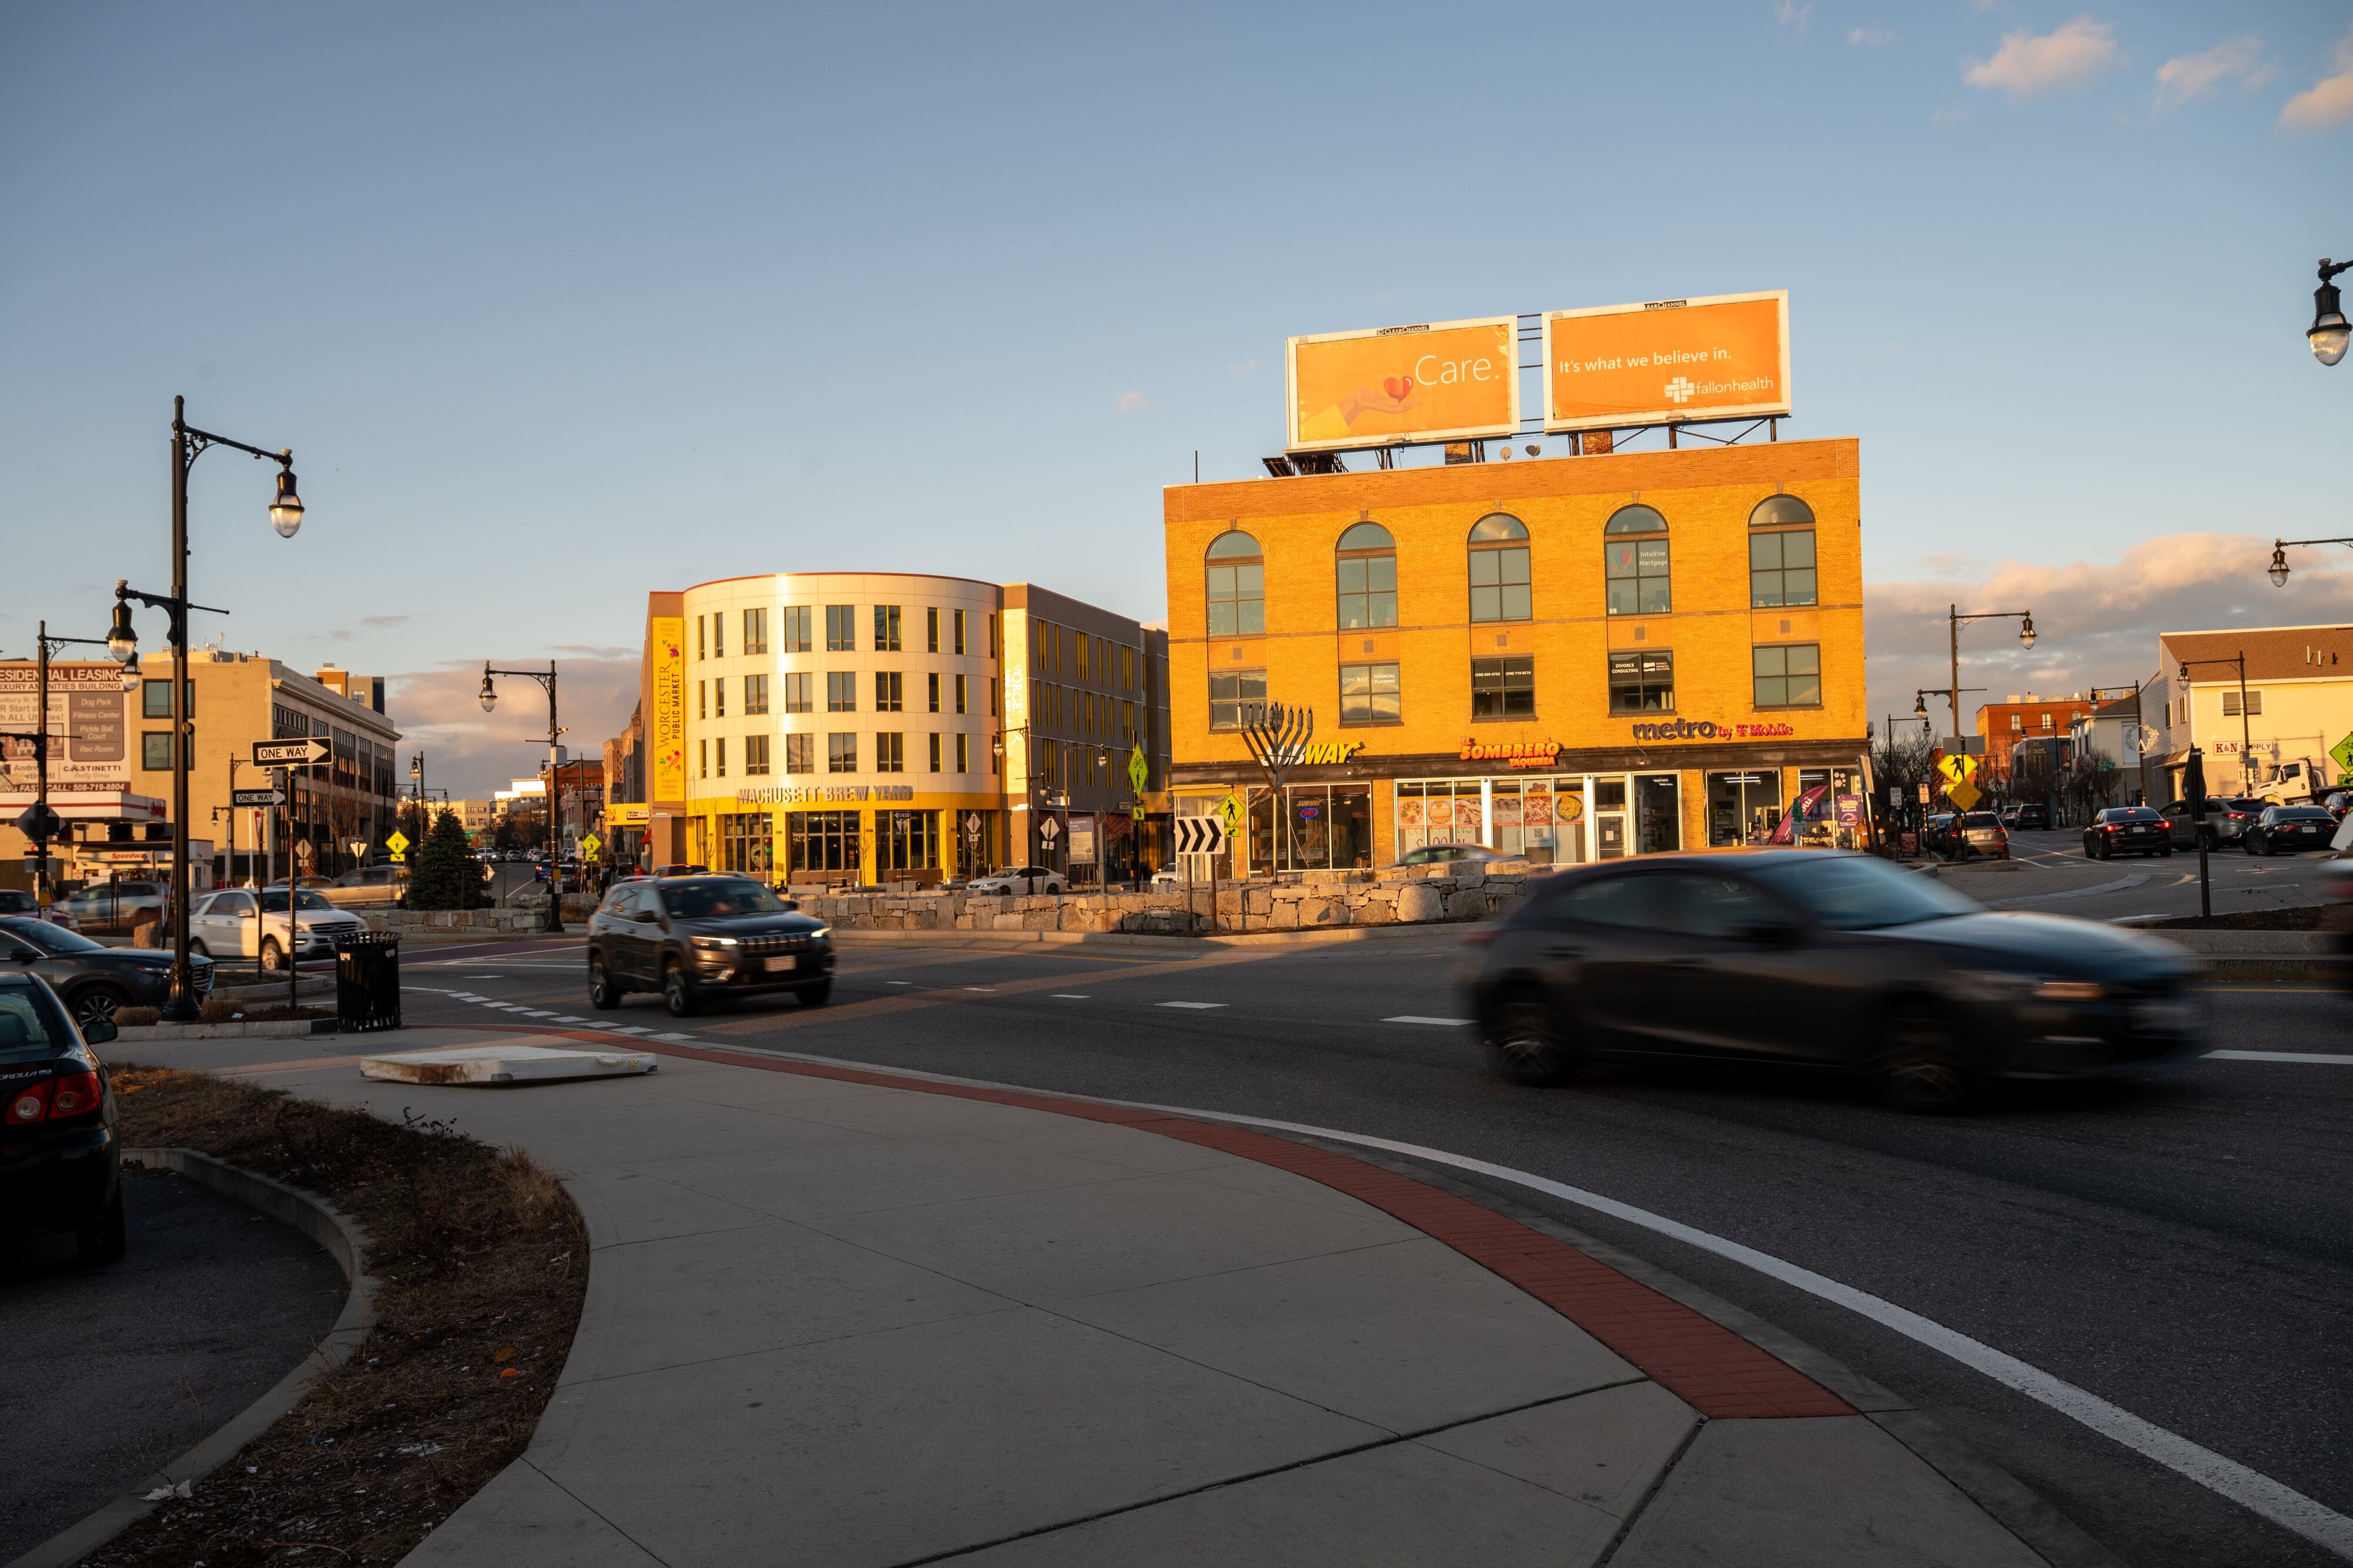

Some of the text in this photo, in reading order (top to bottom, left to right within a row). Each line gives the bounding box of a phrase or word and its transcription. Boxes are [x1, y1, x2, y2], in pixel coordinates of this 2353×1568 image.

[1559, 347, 1732, 373] It's what we believe in.
[1415, 355, 1499, 386] Care.
[1695, 376, 1773, 395] fallonhealth
[70, 669, 123, 681] LEASING
[657, 662, 672, 750] WORCESTER
[672, 672, 680, 739] PUBLIC MARKET
[1632, 717, 1717, 740] metro
[1718, 725, 1733, 740] by
[1461, 736, 1471, 745] EL
[261, 746, 308, 759] ONE WAY
[1260, 742, 1361, 767] SUBWAY
[1459, 741, 1560, 760] SOMBRERO
[1508, 756, 1556, 768] TAQUERIA
[72, 783, 125, 792] 508-719-8804
[738, 785, 914, 805] WACHUSETT BREW YARD
[238, 793, 274, 802] ONE WAY
